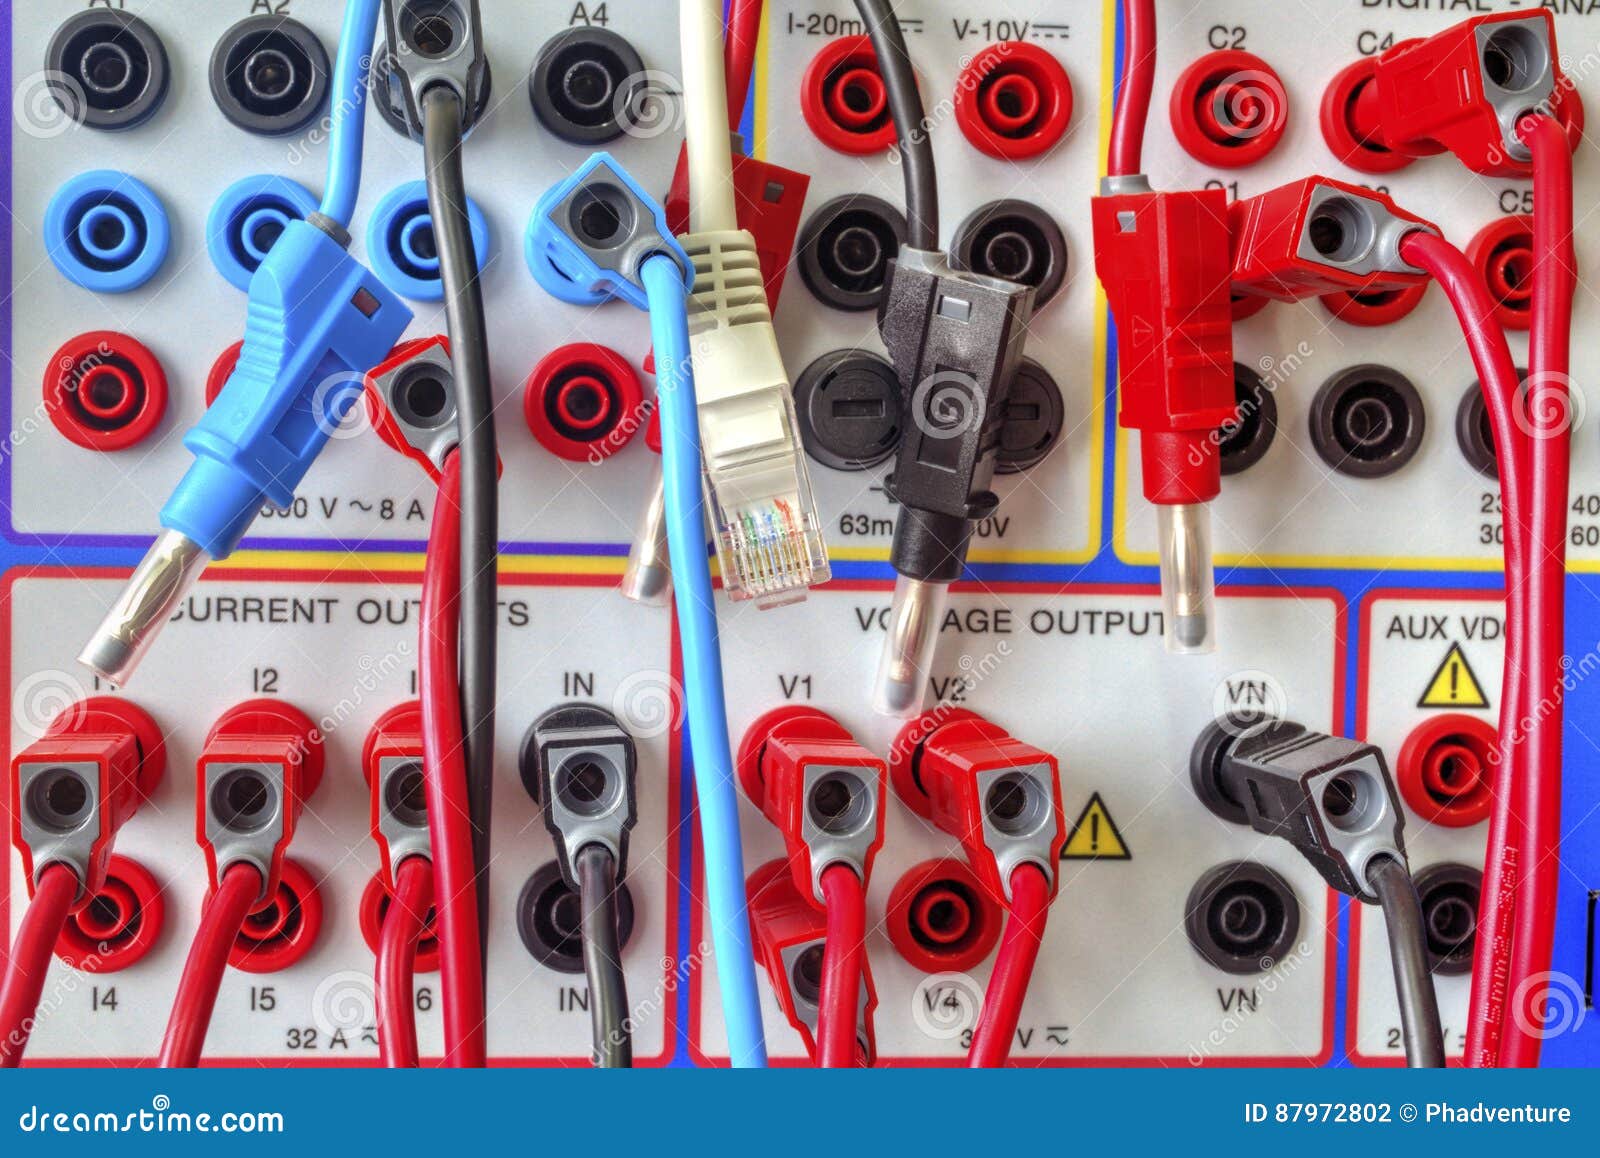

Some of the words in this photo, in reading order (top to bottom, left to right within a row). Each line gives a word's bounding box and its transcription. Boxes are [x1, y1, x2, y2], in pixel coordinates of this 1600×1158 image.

[569, 1, 609, 27] A4
[788, 12, 869, 36] I-20m
[953, 18, 1029, 42] V-10V
[1208, 25, 1247, 50] C2
[1357, 30, 1393, 56] C4
[1499, 189, 1534, 214] C5
[320, 497, 338, 519] V
[406, 499, 425, 520] A
[839, 514, 893, 536] 63m
[971, 516, 1010, 538] 0V
[1385, 615, 1448, 640] AUX
[1460, 616, 1506, 640] VD
[254, 667, 278, 692] I2
[564, 672, 593, 697] IN
[778, 674, 812, 699] V1
[931, 676, 966, 701] V2
[1226, 680, 1266, 704] VN
[92, 986, 118, 1011] I4
[250, 987, 276, 1012] I5
[416, 988, 433, 1011] 6
[560, 987, 588, 1011] IN
[923, 988, 959, 1012] V4
[1217, 988, 1256, 1012] VN
[287, 1028, 318, 1049] 32
[329, 1027, 348, 1049] A
[1018, 1028, 1033, 1049] V
